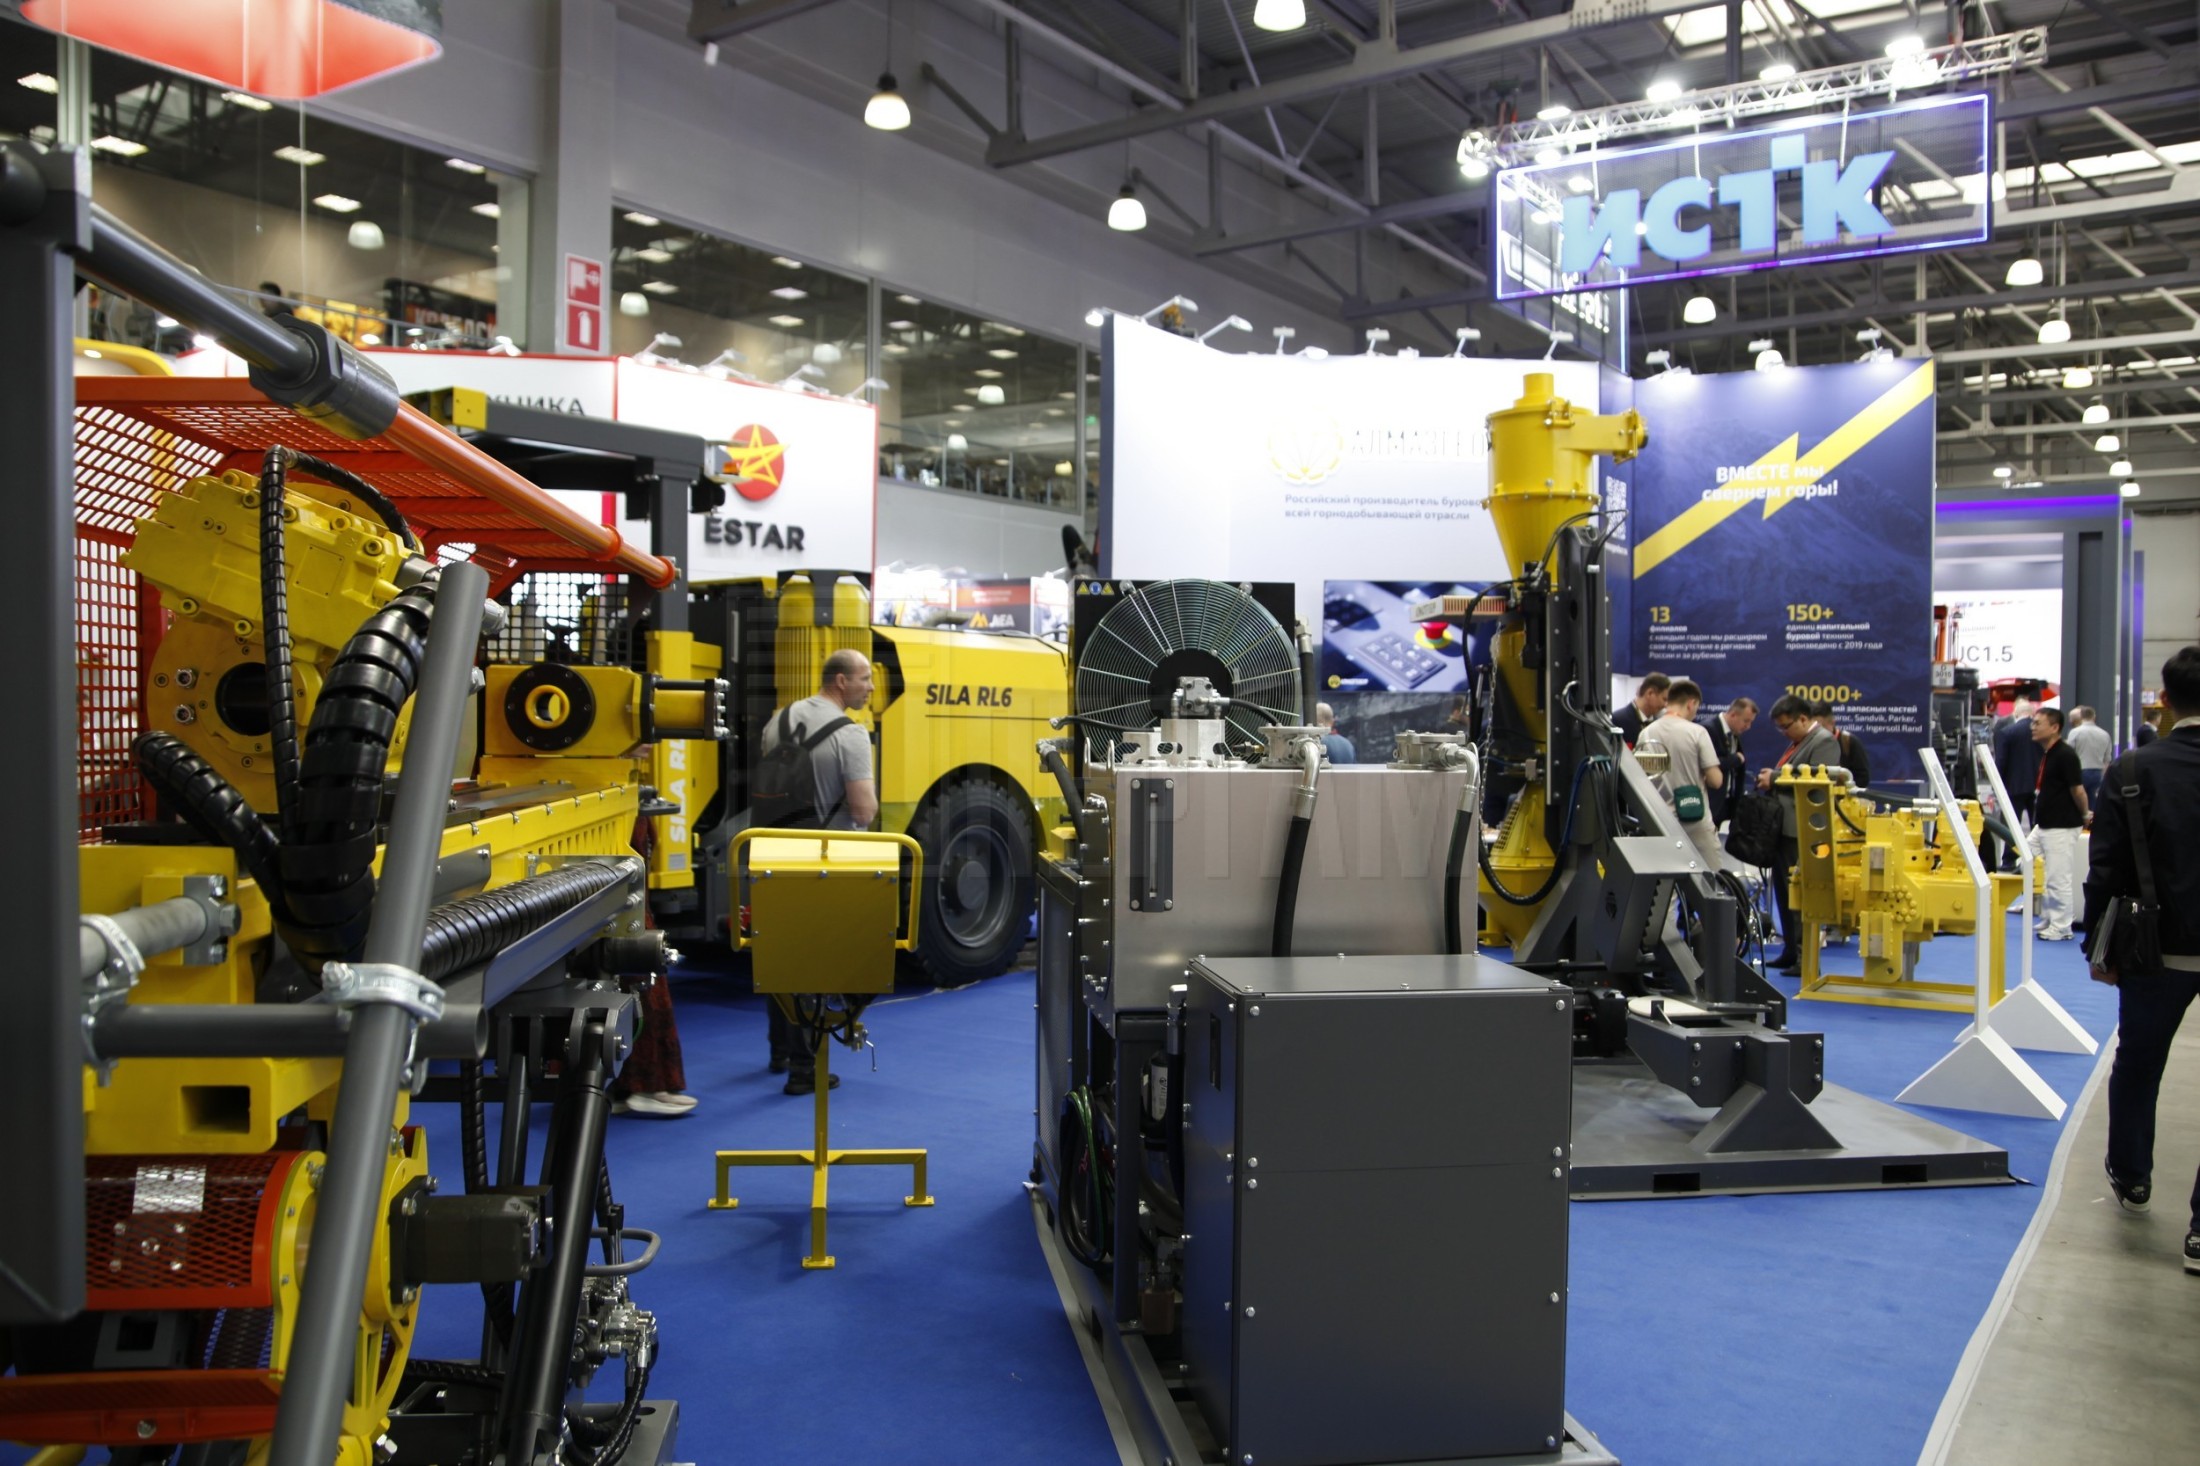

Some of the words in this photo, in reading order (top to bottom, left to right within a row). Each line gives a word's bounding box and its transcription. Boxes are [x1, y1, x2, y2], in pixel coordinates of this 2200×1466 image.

[1716, 464, 1789, 483] ВМЕСТЕ
[1794, 467, 1825, 478] мы
[1702, 485, 1780, 502] свернем
[1786, 480, 1838, 500] горы!
[1285, 494, 1351, 504] Российский
[1353, 496, 1439, 507] производитель
[1285, 508, 1310, 517] всей
[1313, 508, 1421, 519] горнодобывающей
[1424, 511, 1469, 520] отрасли
[704, 516, 805, 551] ESTAR
[1649, 606, 1671, 624] 13
[1786, 604, 1834, 622] 150+
[1817, 622, 1870, 630] капитальной
[1786, 632, 1821, 642] буровой
[1721, 643, 1756, 652] регионах
[1786, 642, 1837, 650] произведено
[1844, 641, 1863, 649] 2019
[1864, 642, 1883, 650] года
[925, 683, 971, 706] SILA
[977, 685, 1013, 708] RL6
[1785, 685, 1862, 703] 10000+
[1847, 705, 1887, 713] запасных
[1888, 705, 1917, 714] частей
[1855, 714, 1887, 723] Sandvik,
[1888, 714, 1917, 724] Parker,
[1866, 724, 1901, 734] Ingersoll
[1902, 725, 1923, 733] Rand
